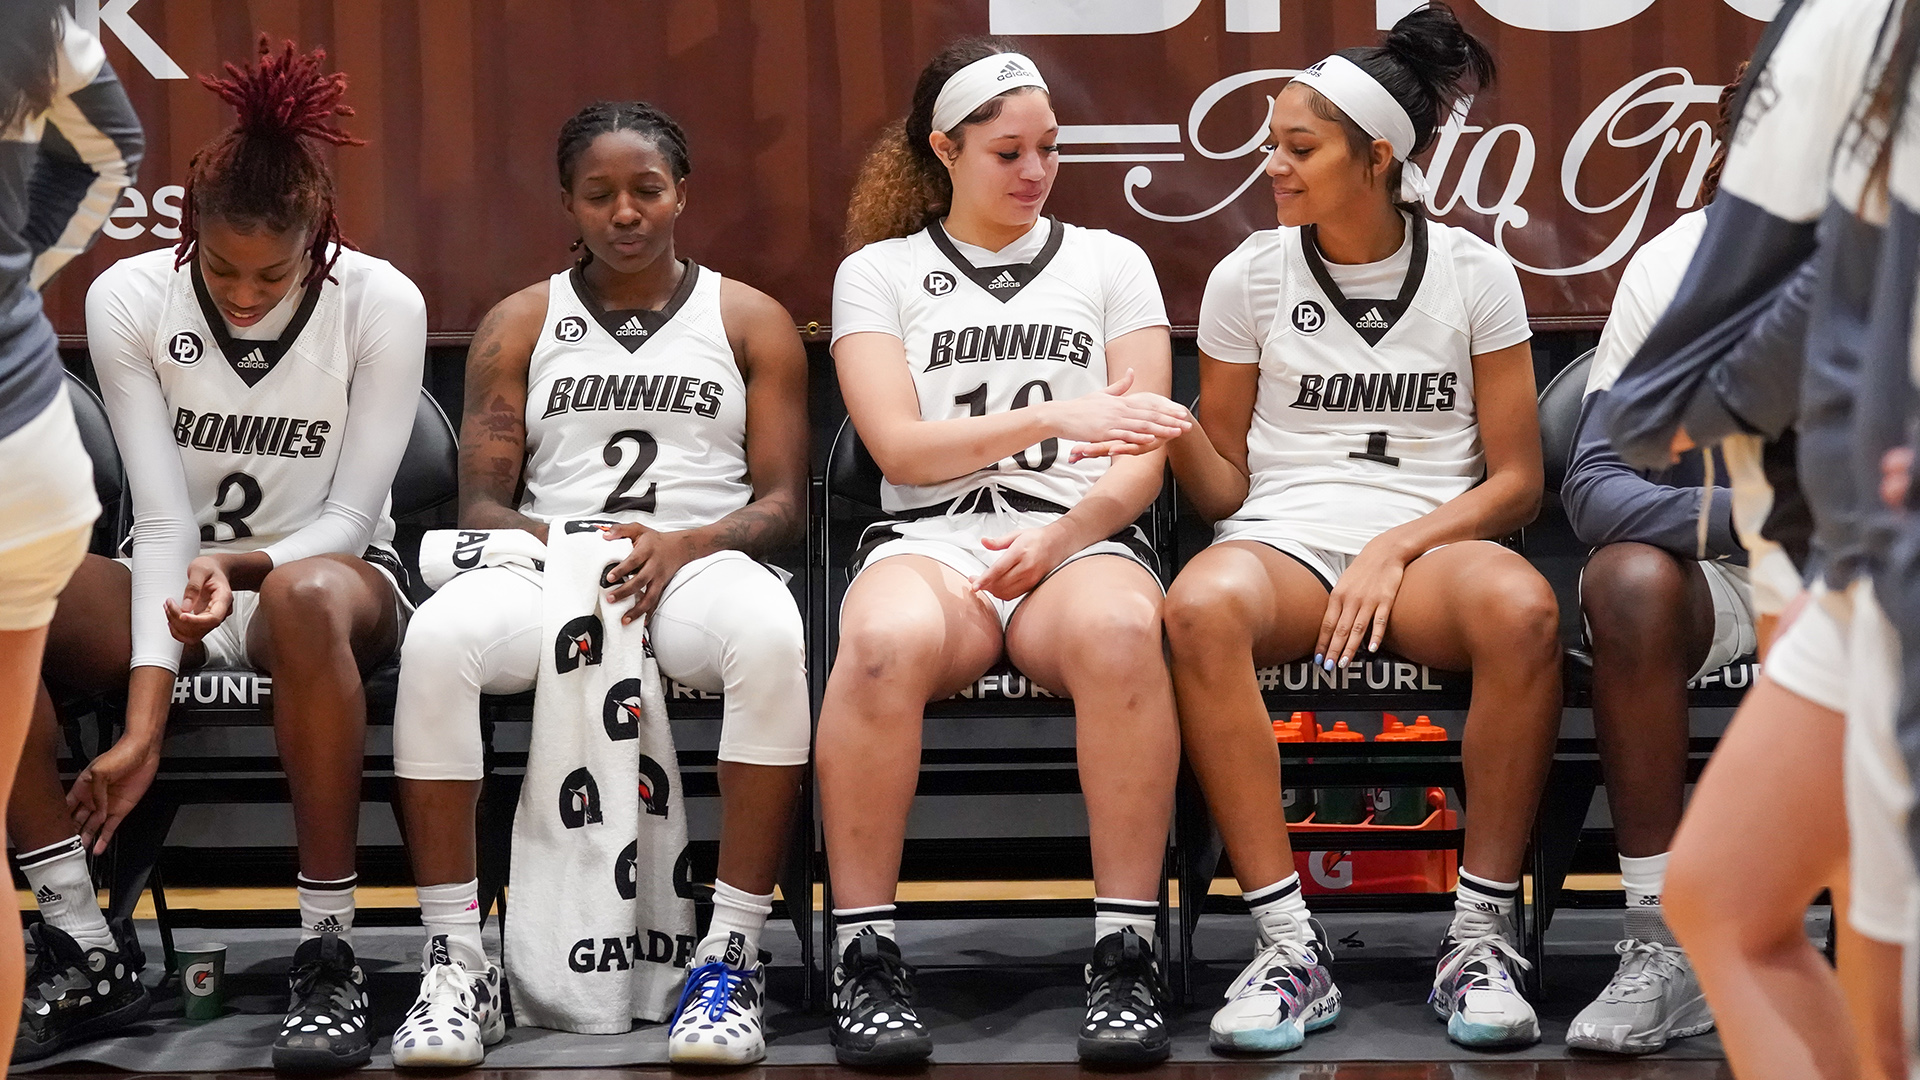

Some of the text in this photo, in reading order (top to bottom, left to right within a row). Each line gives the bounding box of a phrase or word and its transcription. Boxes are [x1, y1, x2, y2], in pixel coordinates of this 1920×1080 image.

[988, 280, 1020, 290] adidas
[616, 327, 648, 336] adidas
[1355, 318, 1388, 329] adidas
[237, 360, 269, 369] adidas
[924, 324, 1093, 373] BONNIES
[541, 374, 724, 420] BONNIES
[1288, 371, 1457, 412] BONNIES
[174, 407, 331, 458] BONNIES
[602, 430, 659, 515] 2
[200, 471, 264, 542] 3
[185, 961, 215, 997] G
